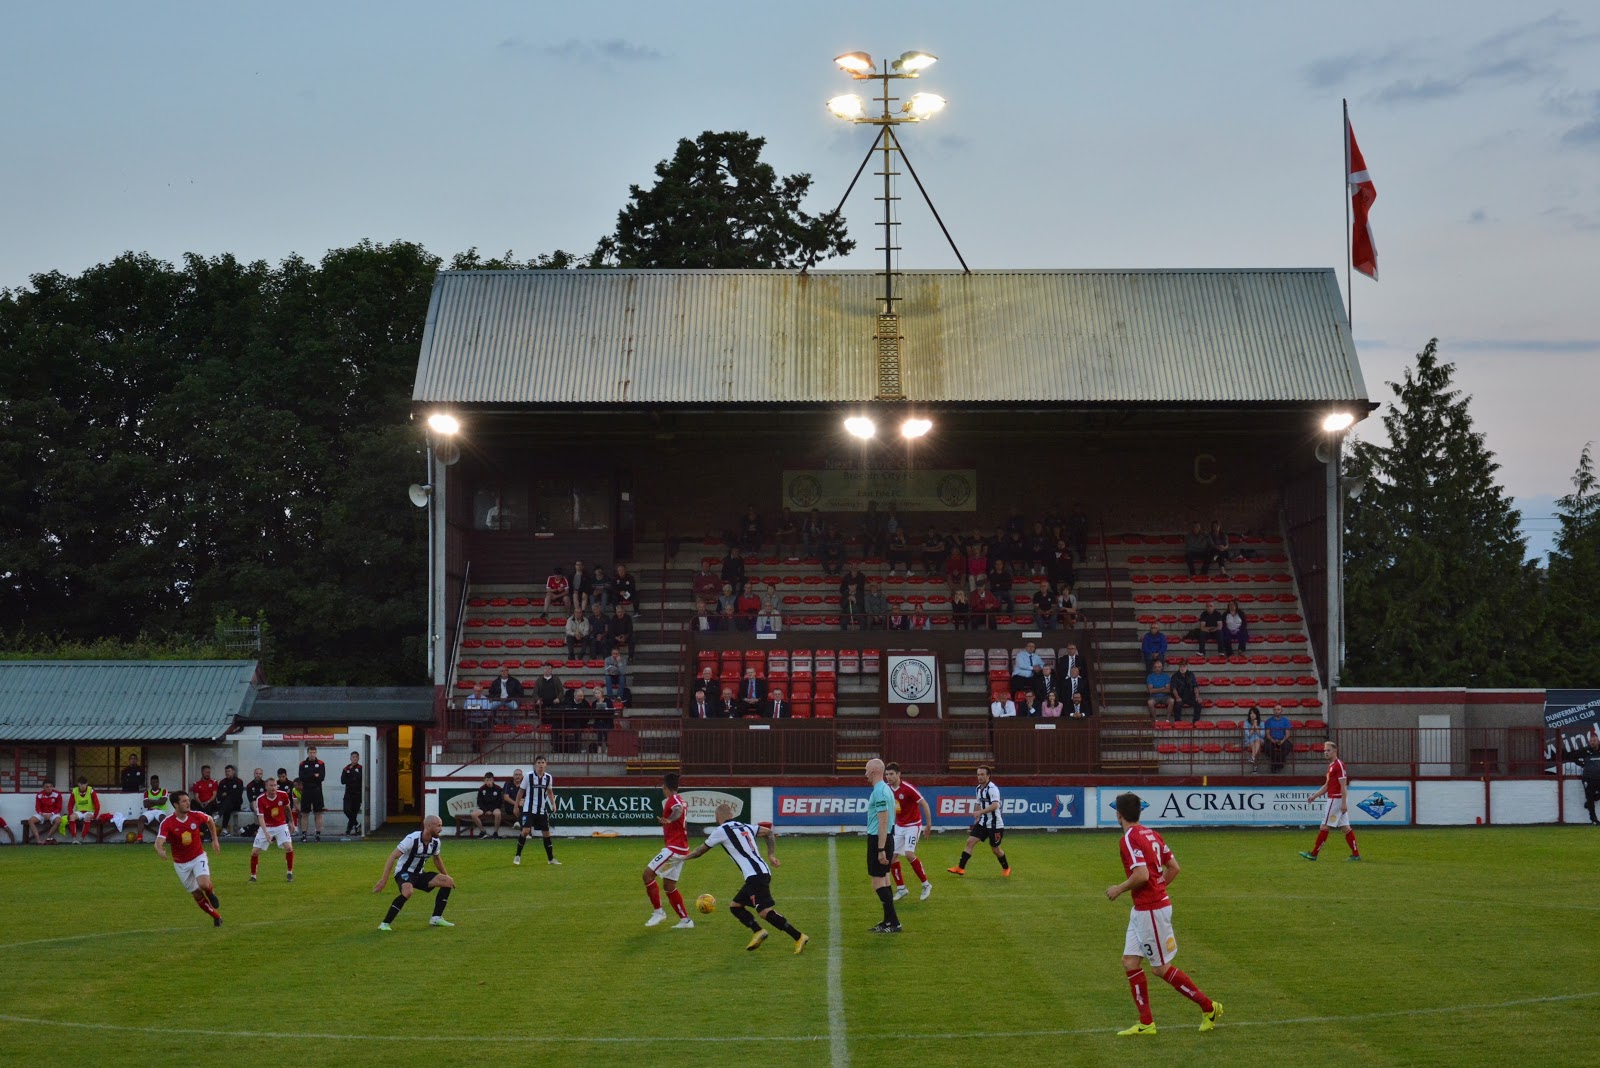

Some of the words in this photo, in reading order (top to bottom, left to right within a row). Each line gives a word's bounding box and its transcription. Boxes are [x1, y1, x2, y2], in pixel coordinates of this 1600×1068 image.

[1545, 703, 1588, 721] DUNFERMLINE
[1548, 715, 1580, 728] FOOTBALL
[1579, 709, 1596, 720] CLUB
[582, 794, 654, 811] FRASER
[781, 798, 869, 813] BETFRED
[940, 798, 1028, 814] BETED
[1029, 802, 1053, 813] CUP
[1273, 803, 1324, 811] CONSULT
[908, 835, 917, 845] 12
[200, 860, 205, 868] 7
[654, 854, 663, 863] 8
[1143, 943, 1154, 956] 3
